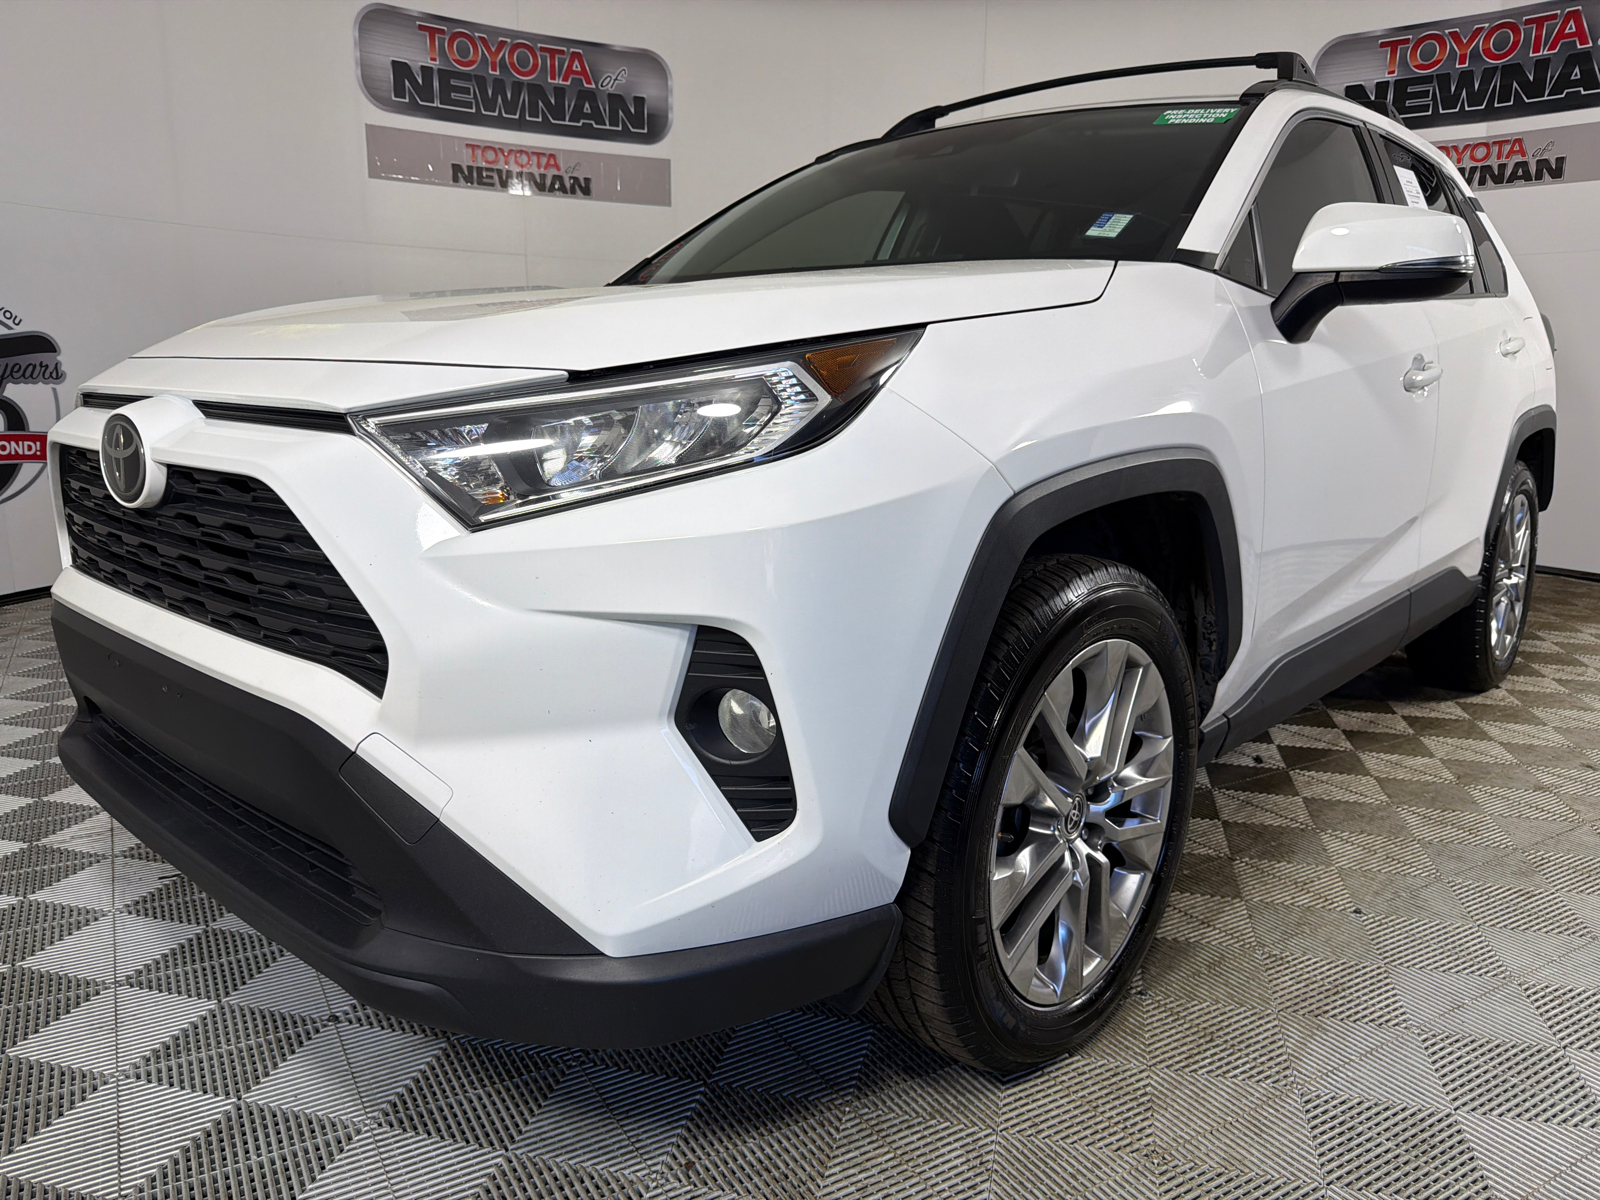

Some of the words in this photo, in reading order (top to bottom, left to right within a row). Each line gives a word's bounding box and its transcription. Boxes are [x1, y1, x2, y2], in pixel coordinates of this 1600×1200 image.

[417, 22, 595, 88] TOYOTA
[599, 67, 627, 90] of
[1378, 6, 1593, 77] TOYOTA
[391, 60, 648, 133] NEWNAN
[465, 143, 561, 172] TOYOTA
[565, 162, 581, 174] of
[1437, 137, 1527, 164] YOTA
[1531, 140, 1555, 158] of
[451, 163, 592, 196] NEWNAN
[1458, 156, 1566, 188] NAN
[0, 306, 23, 327] OU
